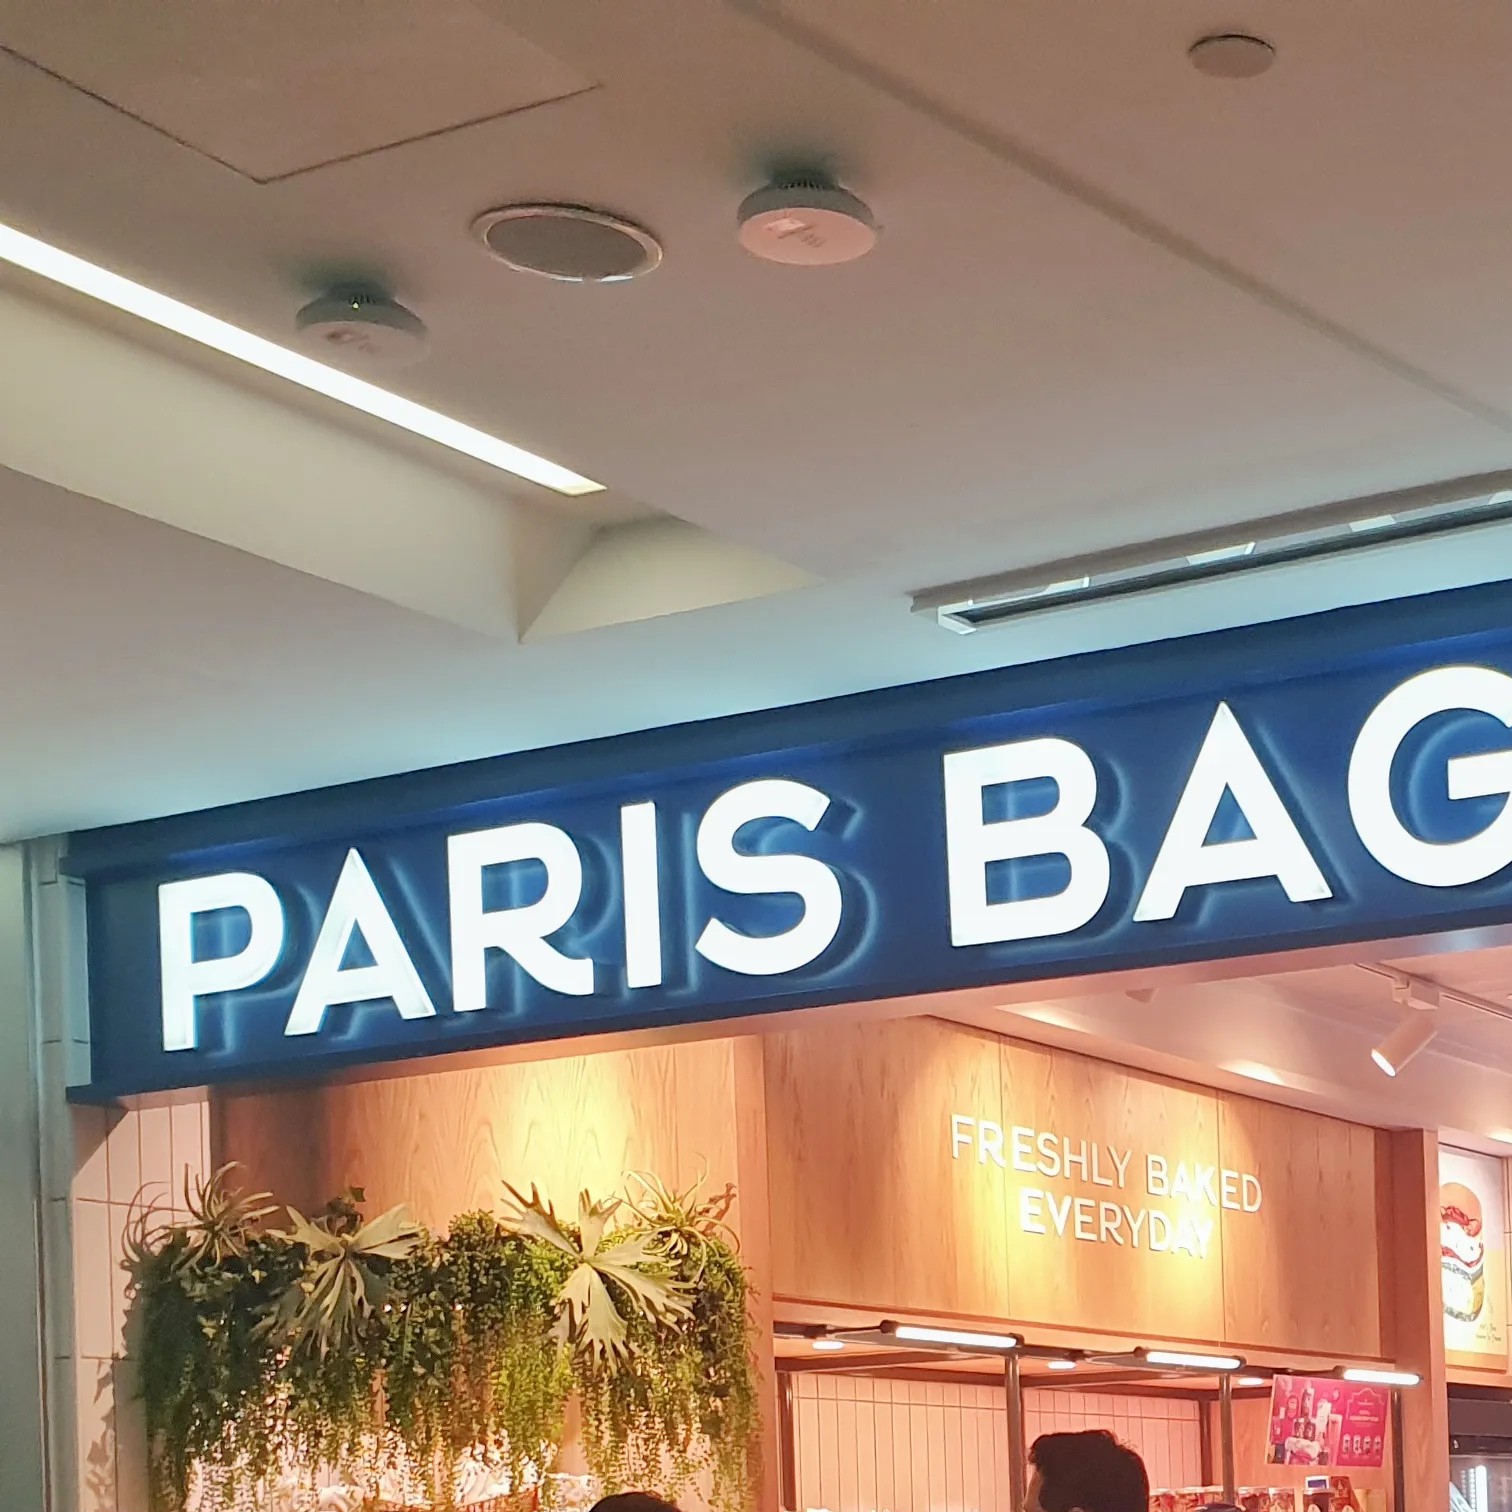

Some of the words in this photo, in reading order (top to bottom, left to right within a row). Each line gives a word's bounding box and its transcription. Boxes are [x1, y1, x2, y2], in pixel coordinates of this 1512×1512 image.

[158, 778, 844, 1052] PARIS
[951, 1114, 1132, 1189] FRESHLY
[1146, 1153, 1263, 1213] BAKED
[1019, 1187, 1214, 1259] EVERYDAY
